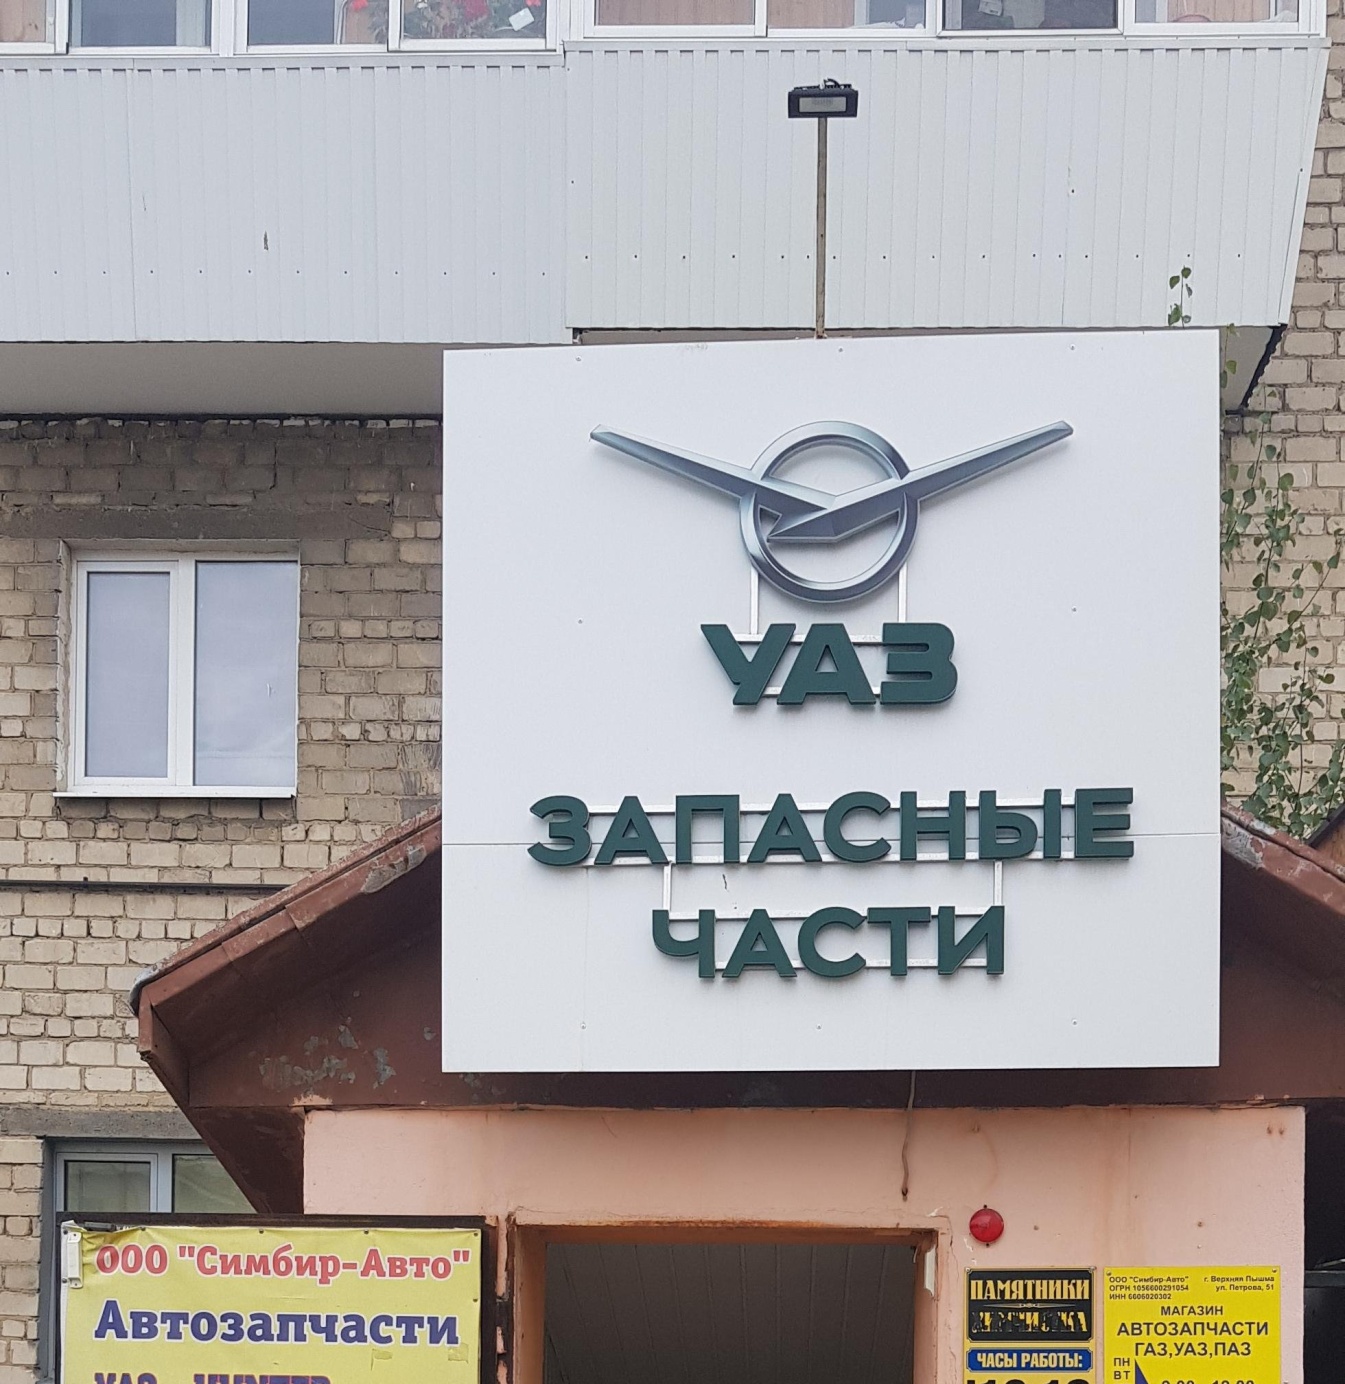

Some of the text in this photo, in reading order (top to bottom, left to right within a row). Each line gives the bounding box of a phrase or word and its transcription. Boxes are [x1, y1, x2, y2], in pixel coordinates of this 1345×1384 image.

[700, 622, 958, 706] УАЗ
[527, 787, 1134, 866] ЗАПАСНЫЕ
[652, 905, 1005, 978] ЧАСТИ
[96, 1243, 470, 1285] ООО "Симбир-Авто"
[1210, 1275, 1244, 1283] Верхняя
[970, 1279, 1090, 1300] ПАМЯТНИКИ
[1109, 1284, 1189, 1292] ОГРН 1056600291054
[1160, 1305, 1224, 1316] МАГАЗИН
[94, 1299, 460, 1345] Автозапчасти
[1117, 1321, 1269, 1336] АВТОЗАПЧАСТИ
[1134, 1341, 1252, 1359] ГАЗ,УАЗ,ПАЗ
[976, 1352, 1083, 1368] ЧАСЫ РАБОТЫ:
[1113, 1357, 1131, 1367] ПН
[1113, 1370, 1131, 1380] ВТ
